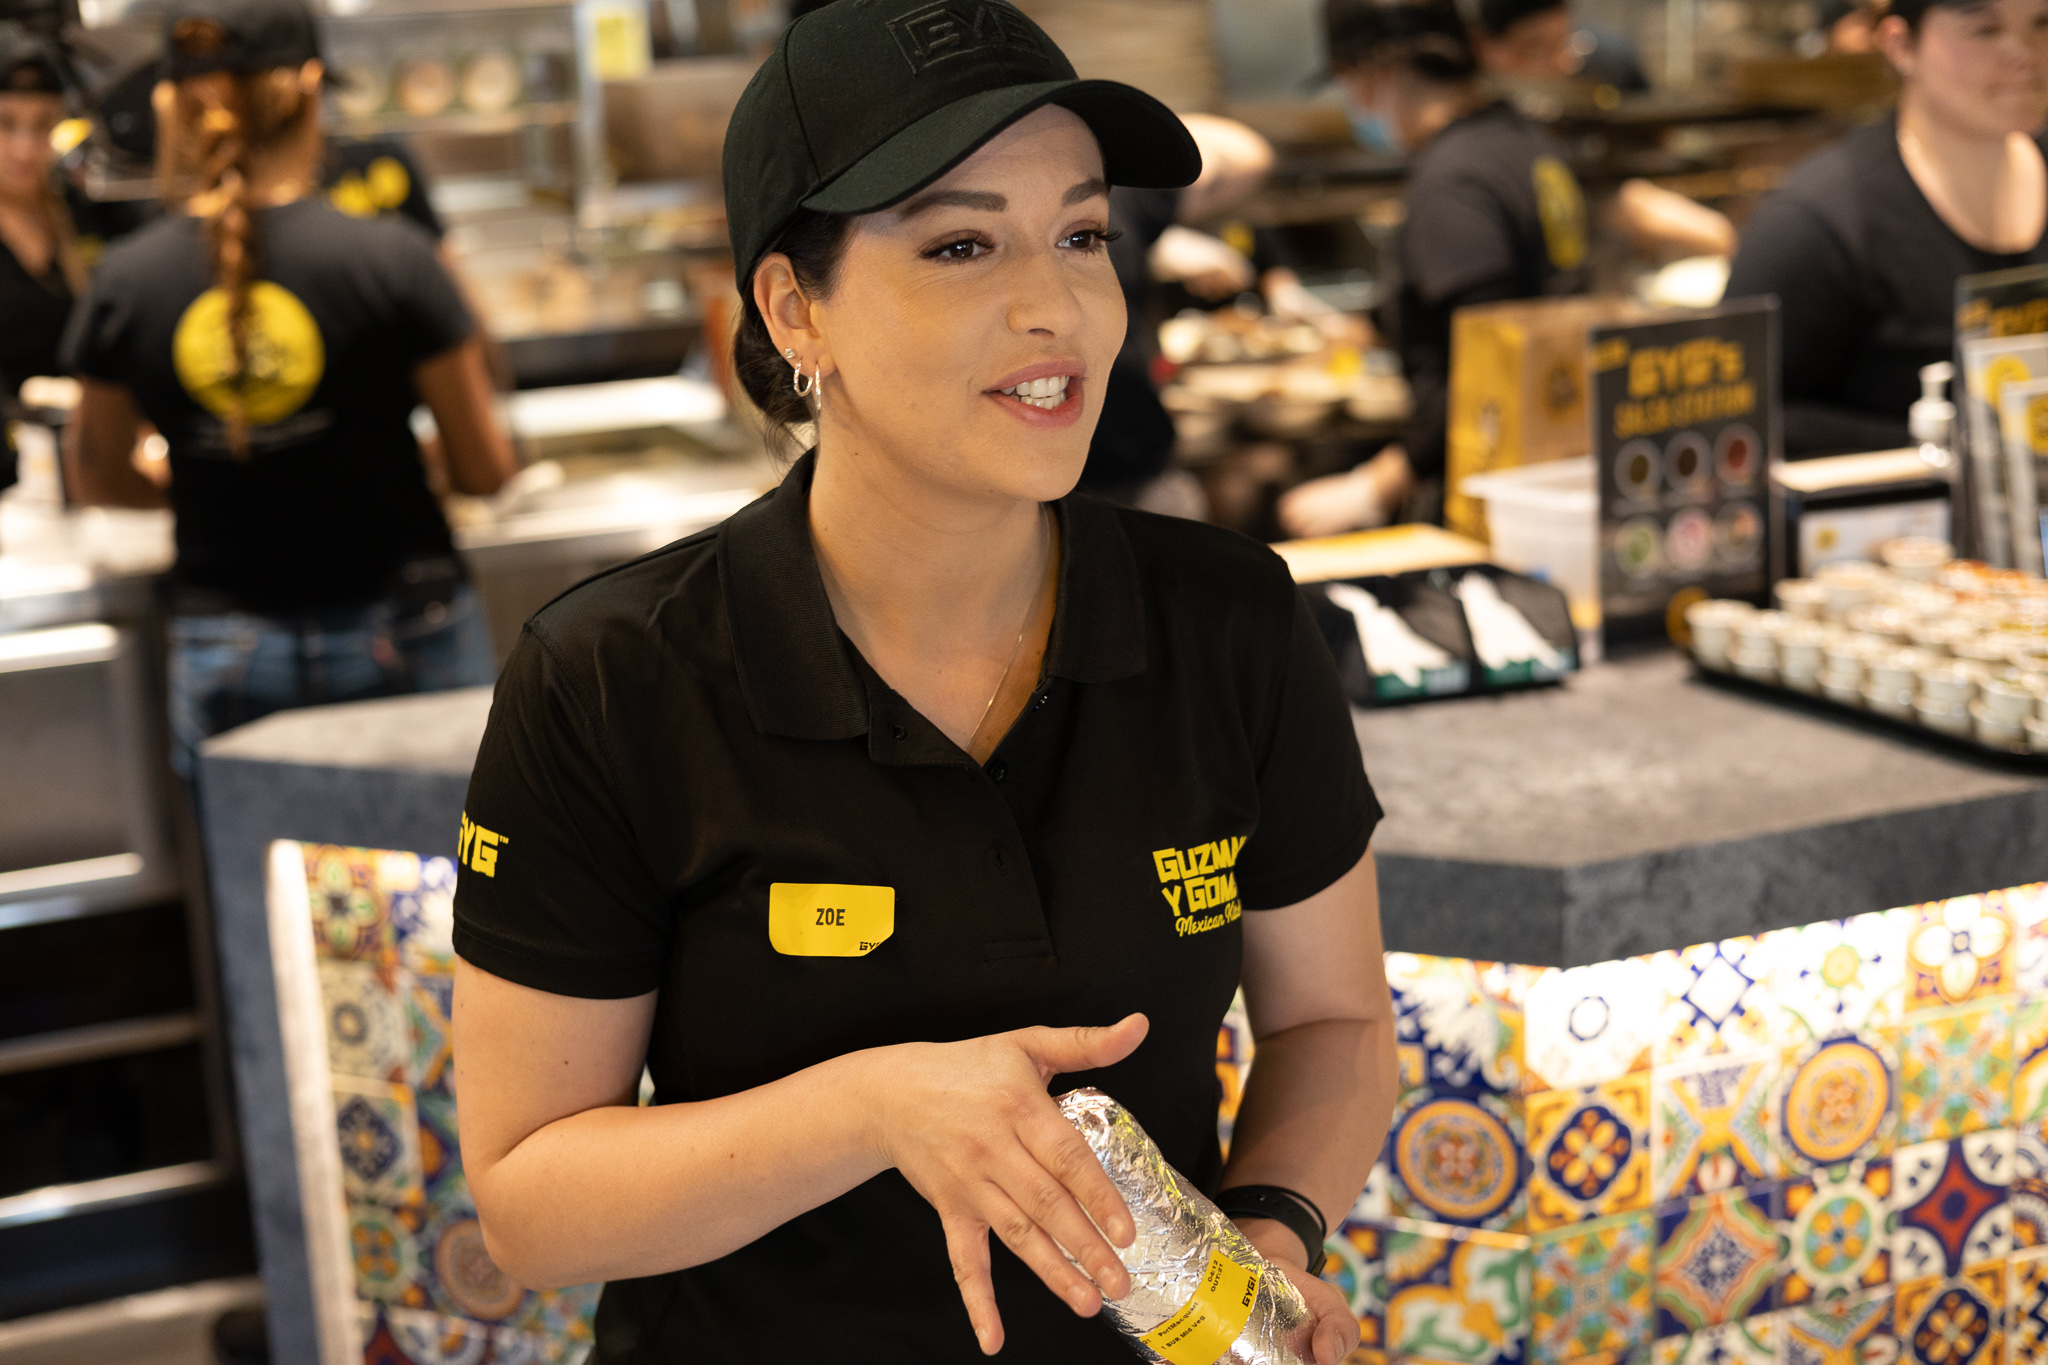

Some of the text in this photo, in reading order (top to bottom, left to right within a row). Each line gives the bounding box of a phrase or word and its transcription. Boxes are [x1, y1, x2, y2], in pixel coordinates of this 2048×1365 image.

[1161, 871, 1238, 917] Y GOM
[816, 908, 846, 926] ZOE
[1175, 915, 1225, 937] Mexican
[1242, 1276, 1256, 1307] GYG!
[1166, 1337, 1181, 1347] BUR
[1191, 1315, 1206, 1328] Veg
